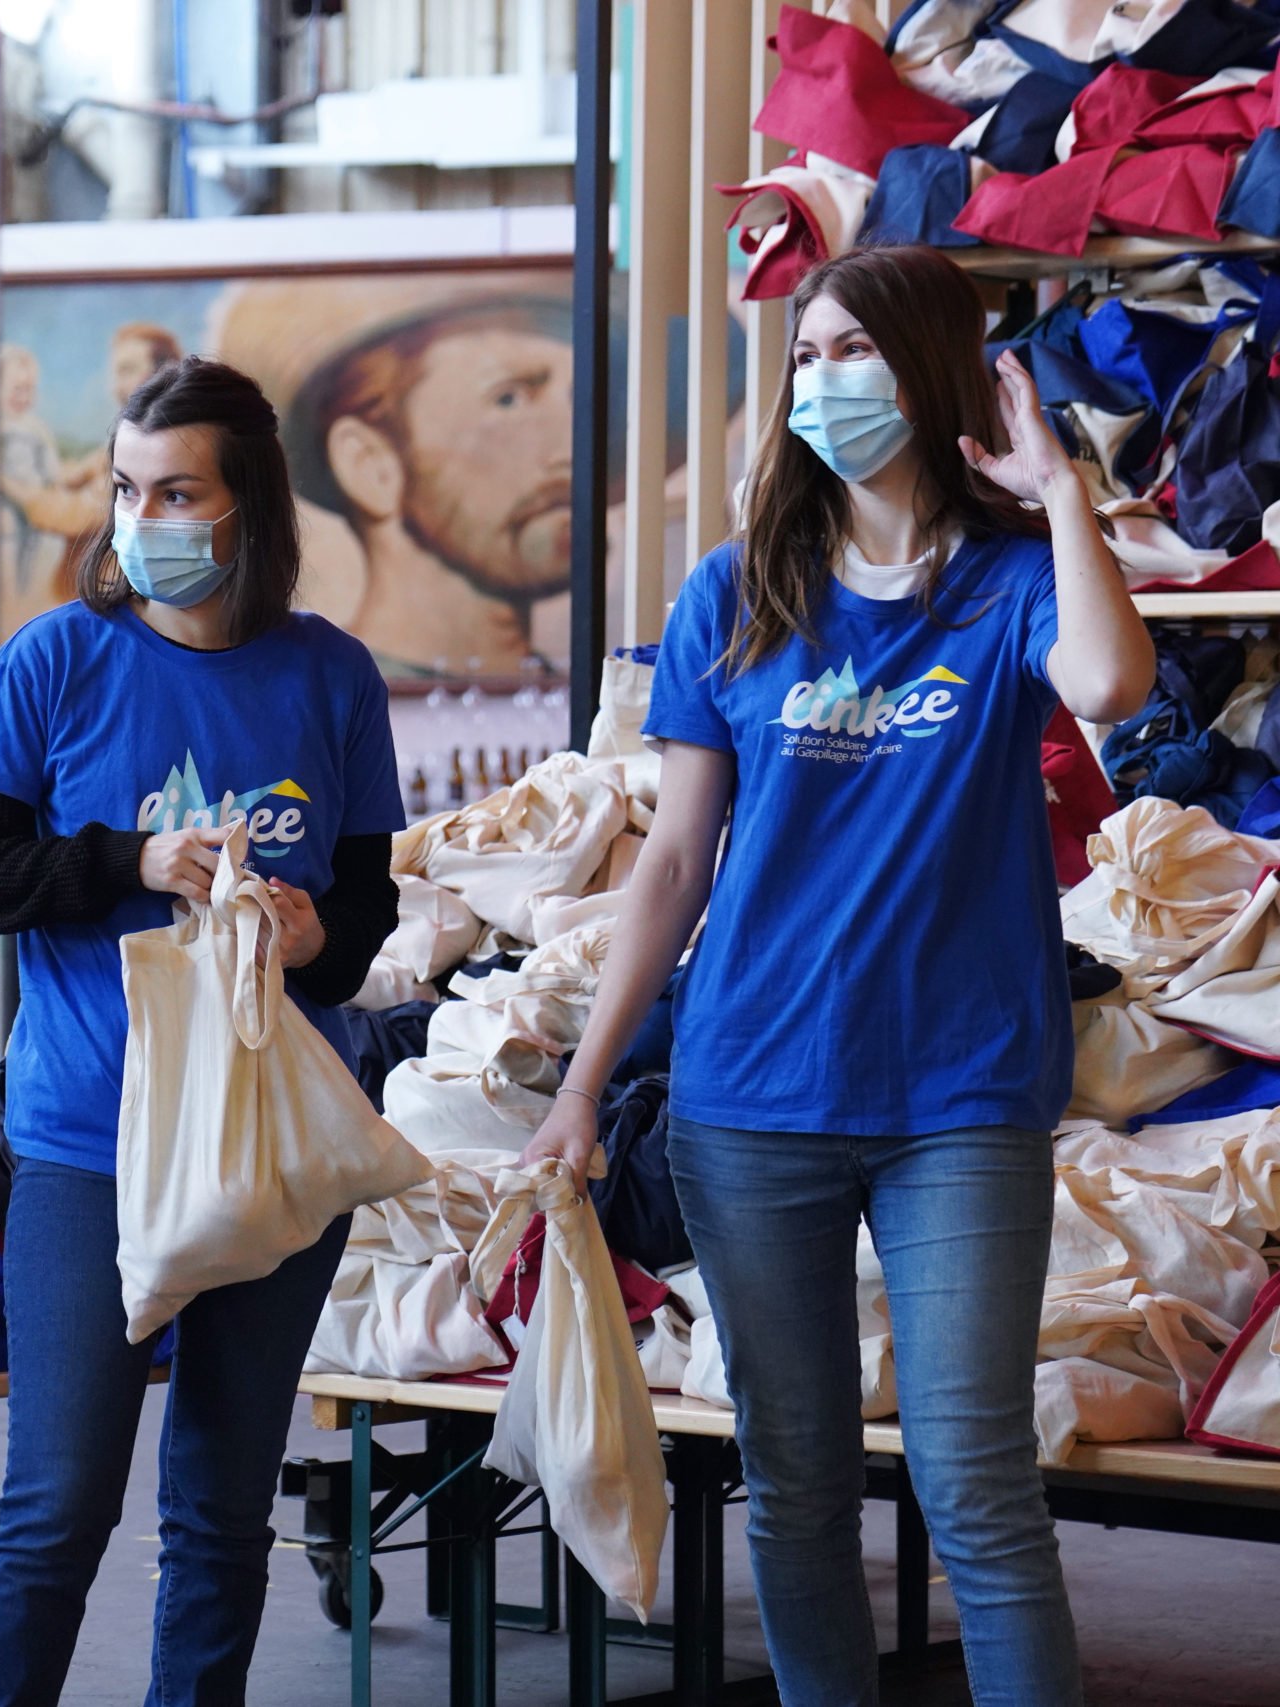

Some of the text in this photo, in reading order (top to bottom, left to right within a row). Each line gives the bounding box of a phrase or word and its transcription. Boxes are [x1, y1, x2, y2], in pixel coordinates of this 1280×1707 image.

[781, 681, 960, 738] linkee
[783, 733, 868, 752] Solution Solidaire
[780, 743, 903, 764] au Gaspillage Alimntaire
